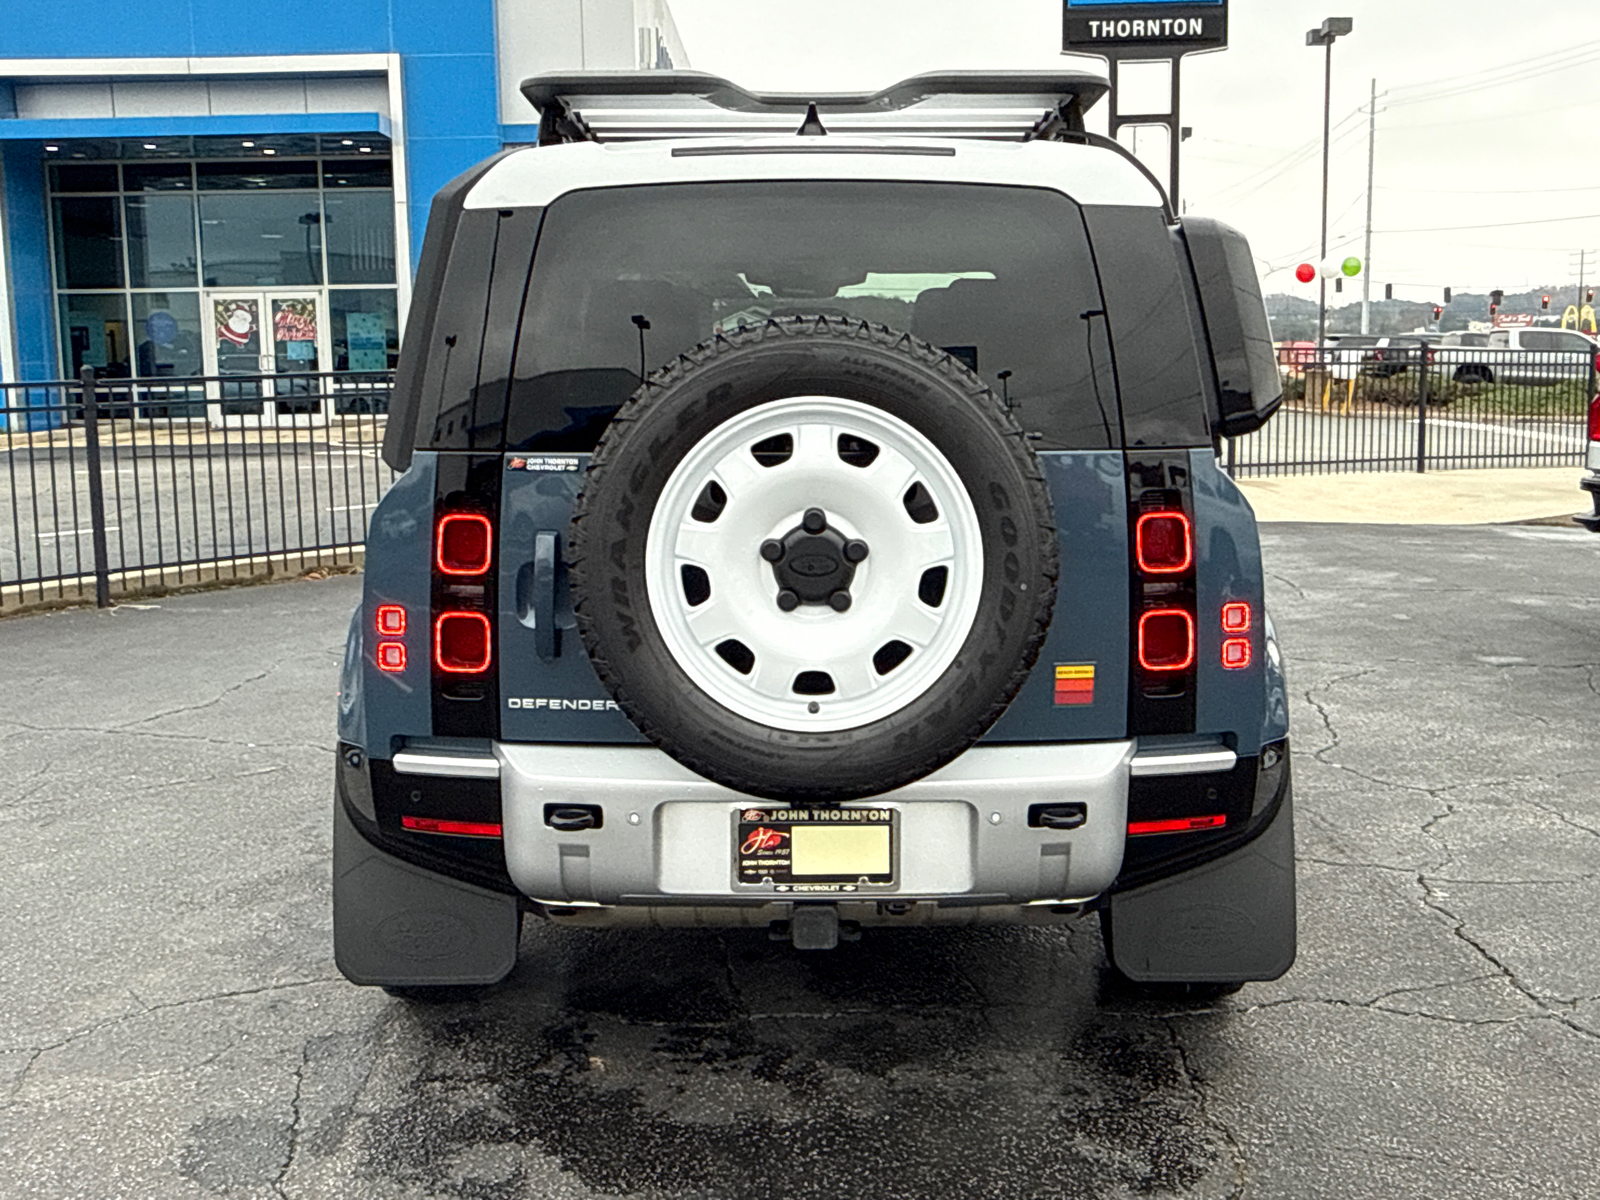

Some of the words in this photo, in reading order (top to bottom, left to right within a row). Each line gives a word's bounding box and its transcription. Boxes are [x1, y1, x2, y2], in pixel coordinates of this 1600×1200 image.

[1088, 18, 1203, 37] THORNTON
[508, 698, 620, 711] DEFENDER
[771, 810, 809, 821] JOHN
[813, 810, 890, 821] THORNTON
